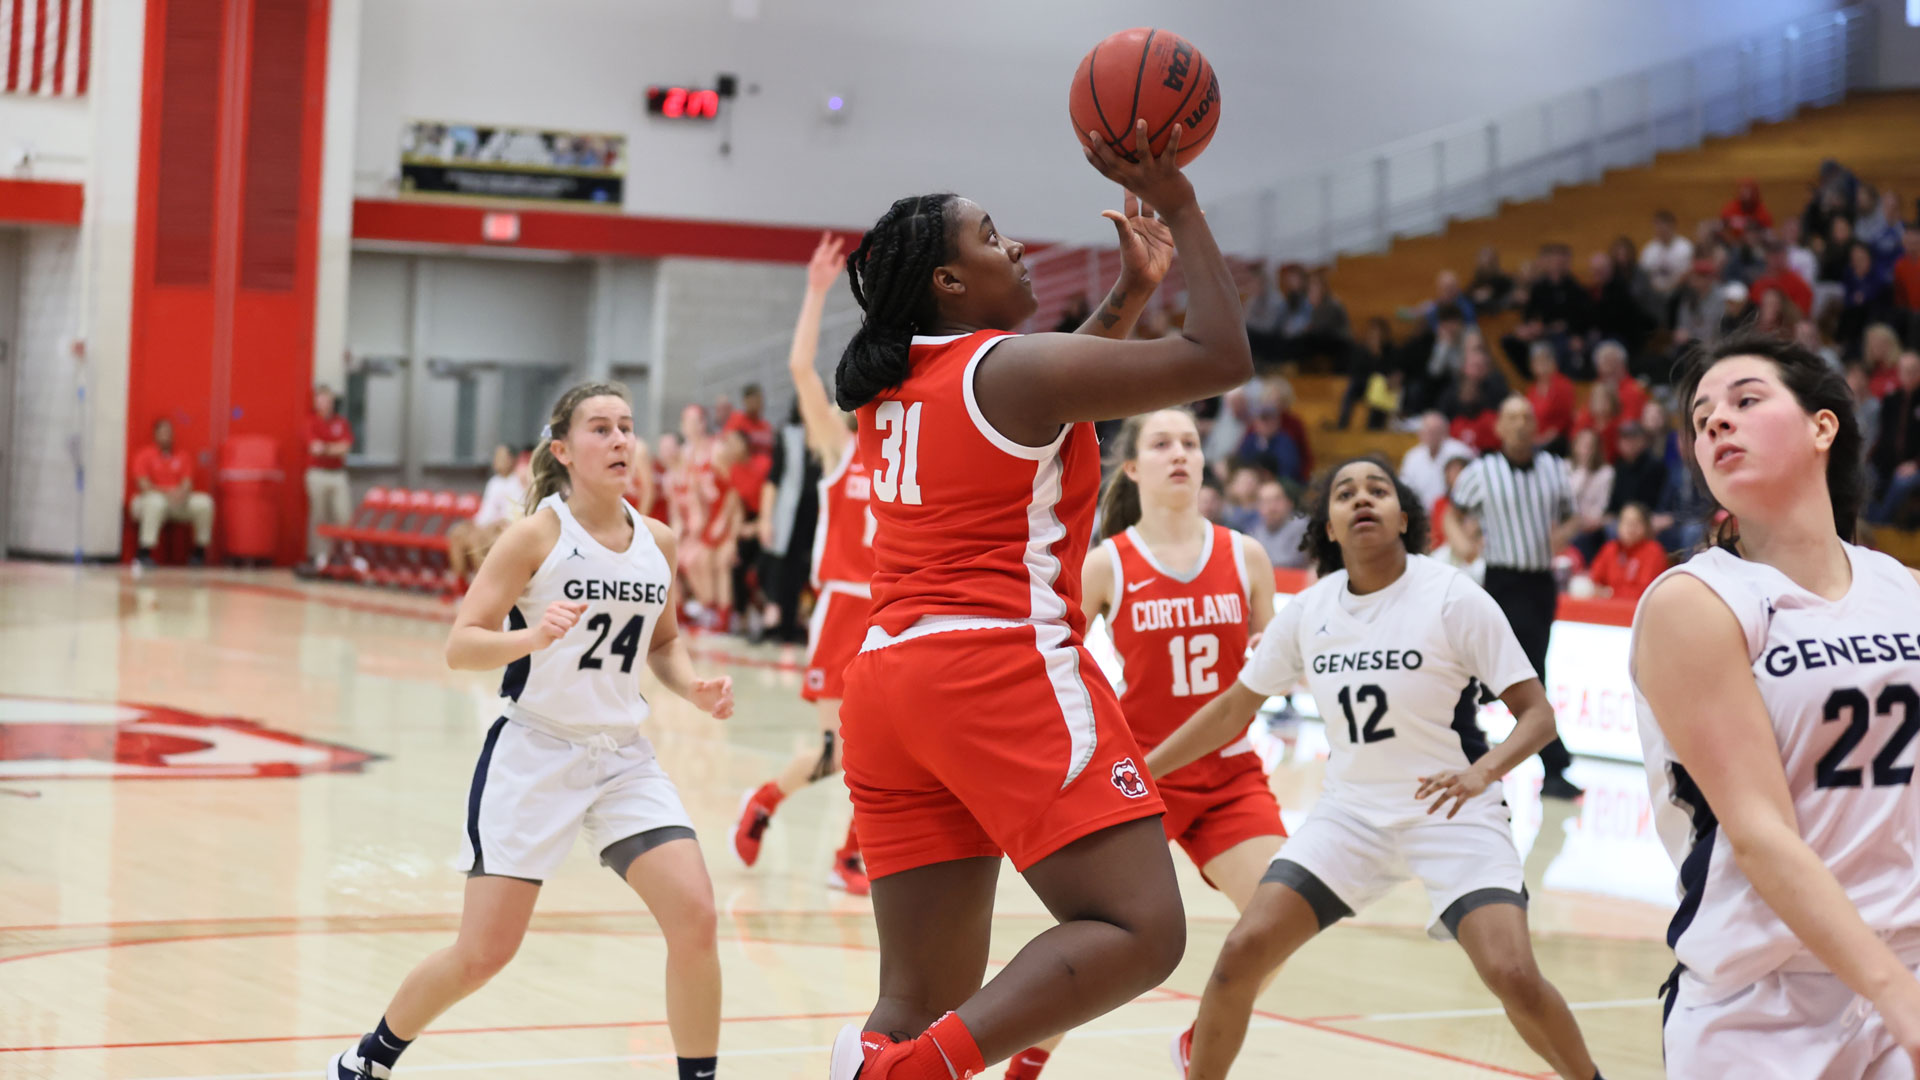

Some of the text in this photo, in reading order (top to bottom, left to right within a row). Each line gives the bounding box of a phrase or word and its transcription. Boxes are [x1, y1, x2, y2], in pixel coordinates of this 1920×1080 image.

[1184, 68, 1221, 129] lson
[873, 401, 923, 505] 31
[563, 579, 667, 605] GENESEO
[1131, 593, 1242, 632] CORTLAND
[577, 612, 645, 674] 24
[1168, 633, 1219, 697] 12
[1313, 649, 1423, 674] GENESEO
[1765, 633, 1920, 677] GENESE
[1337, 684, 1396, 744] 12
[1814, 683, 1920, 790] 22
